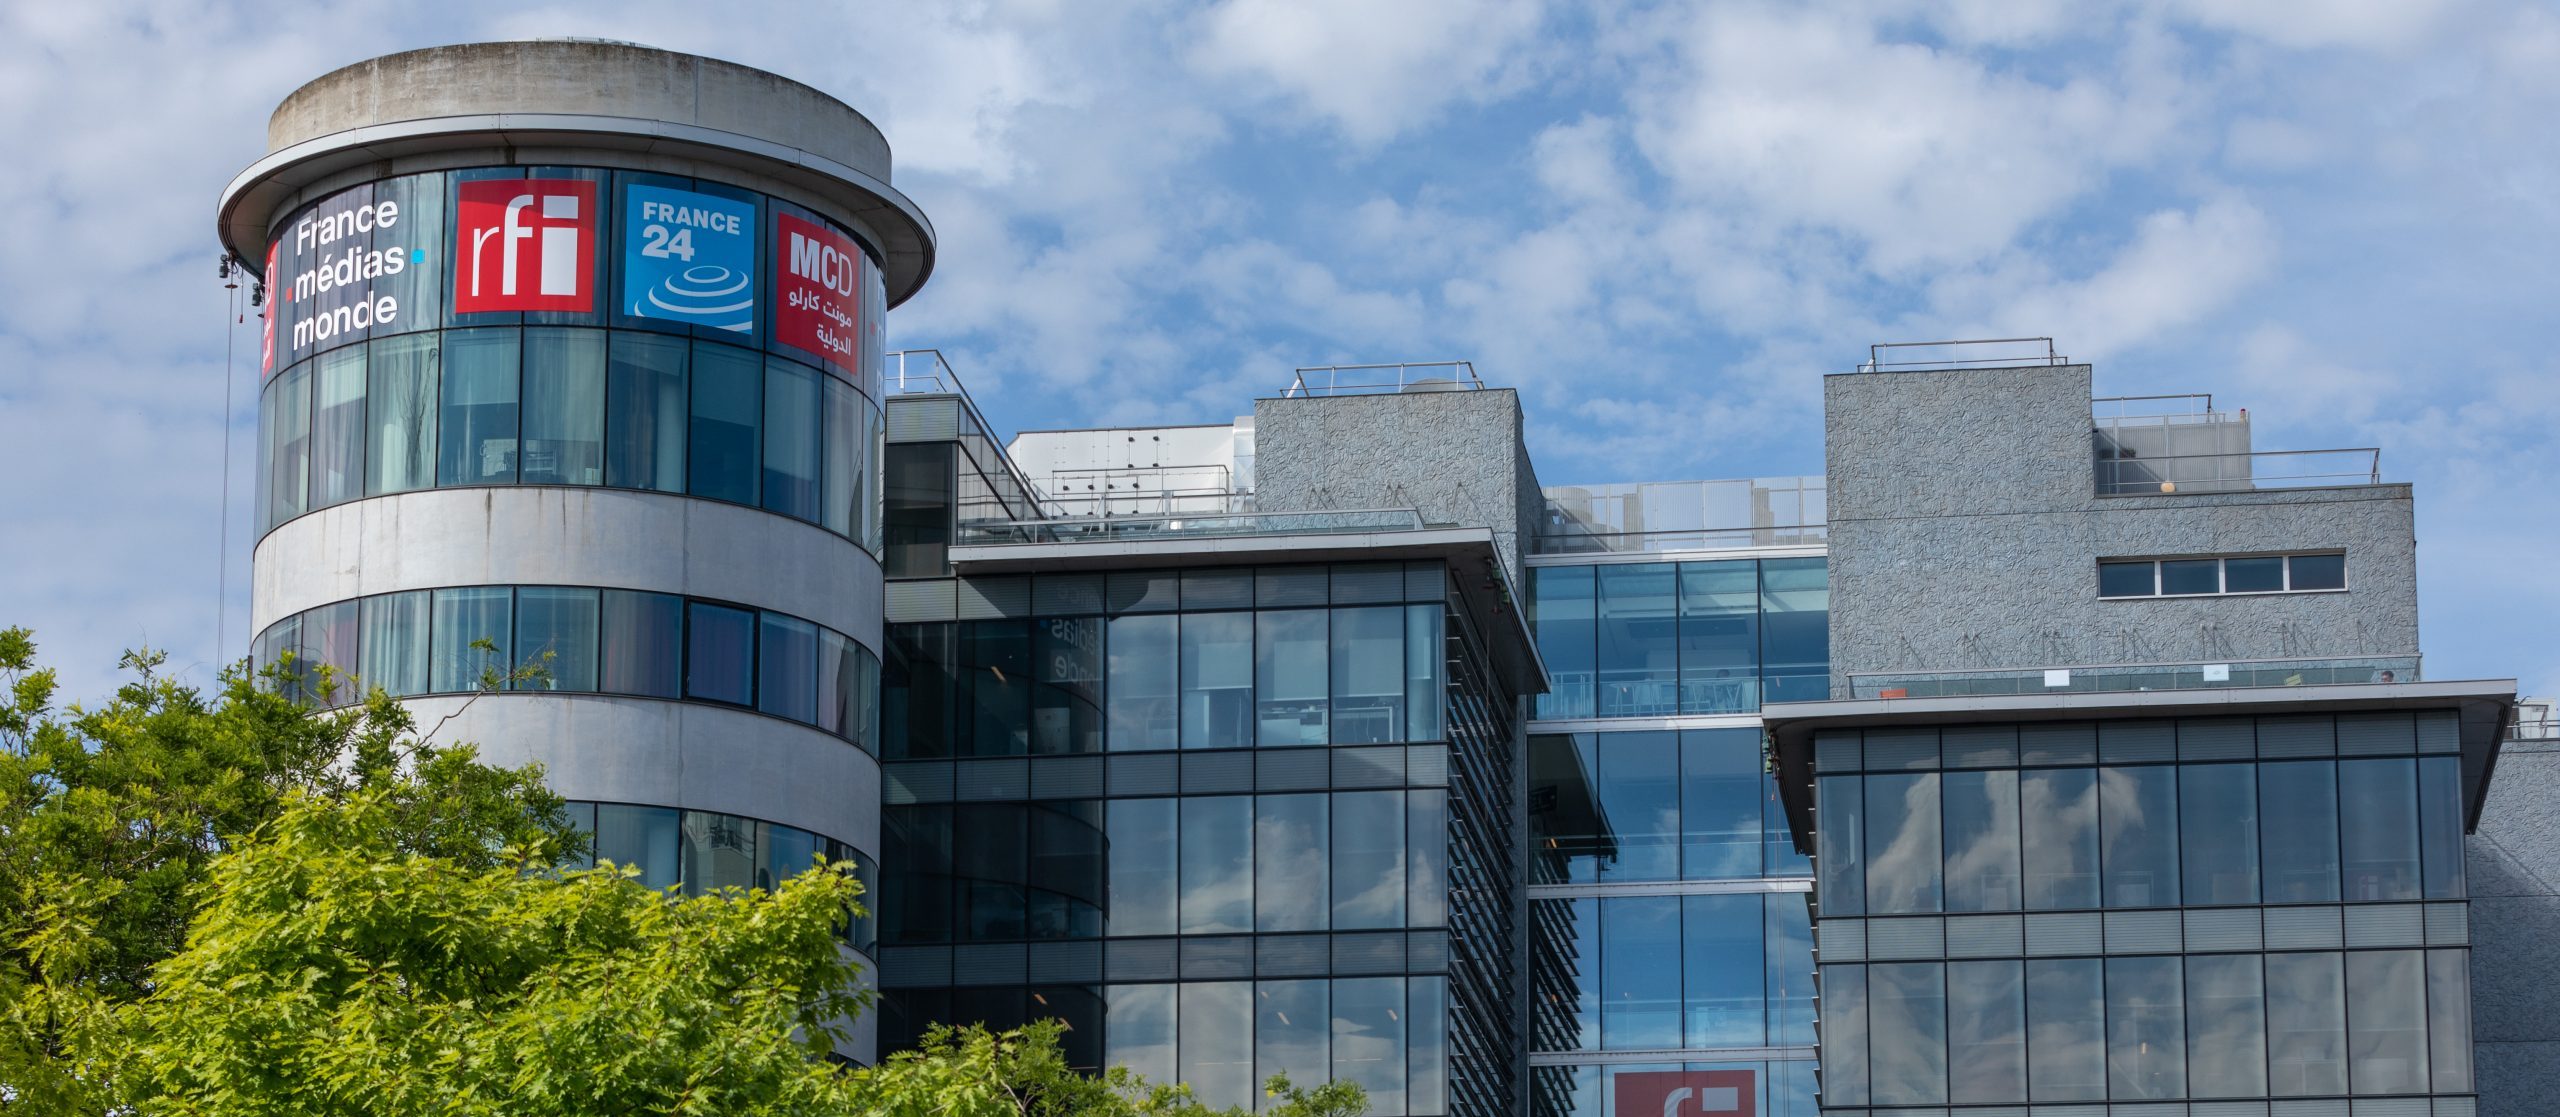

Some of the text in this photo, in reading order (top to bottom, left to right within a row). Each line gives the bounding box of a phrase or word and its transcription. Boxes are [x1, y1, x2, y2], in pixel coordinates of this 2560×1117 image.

[297, 200, 398, 256] France
[471, 194, 578, 296] rfi
[641, 224, 695, 262] 24
[642, 201, 741, 235] FRANCE
[295, 246, 405, 303] médias
[790, 231, 853, 297] MCD
[293, 290, 398, 351] monde
[789, 287, 852, 328] مونت كارلو
[816, 323, 852, 356] الدولية
